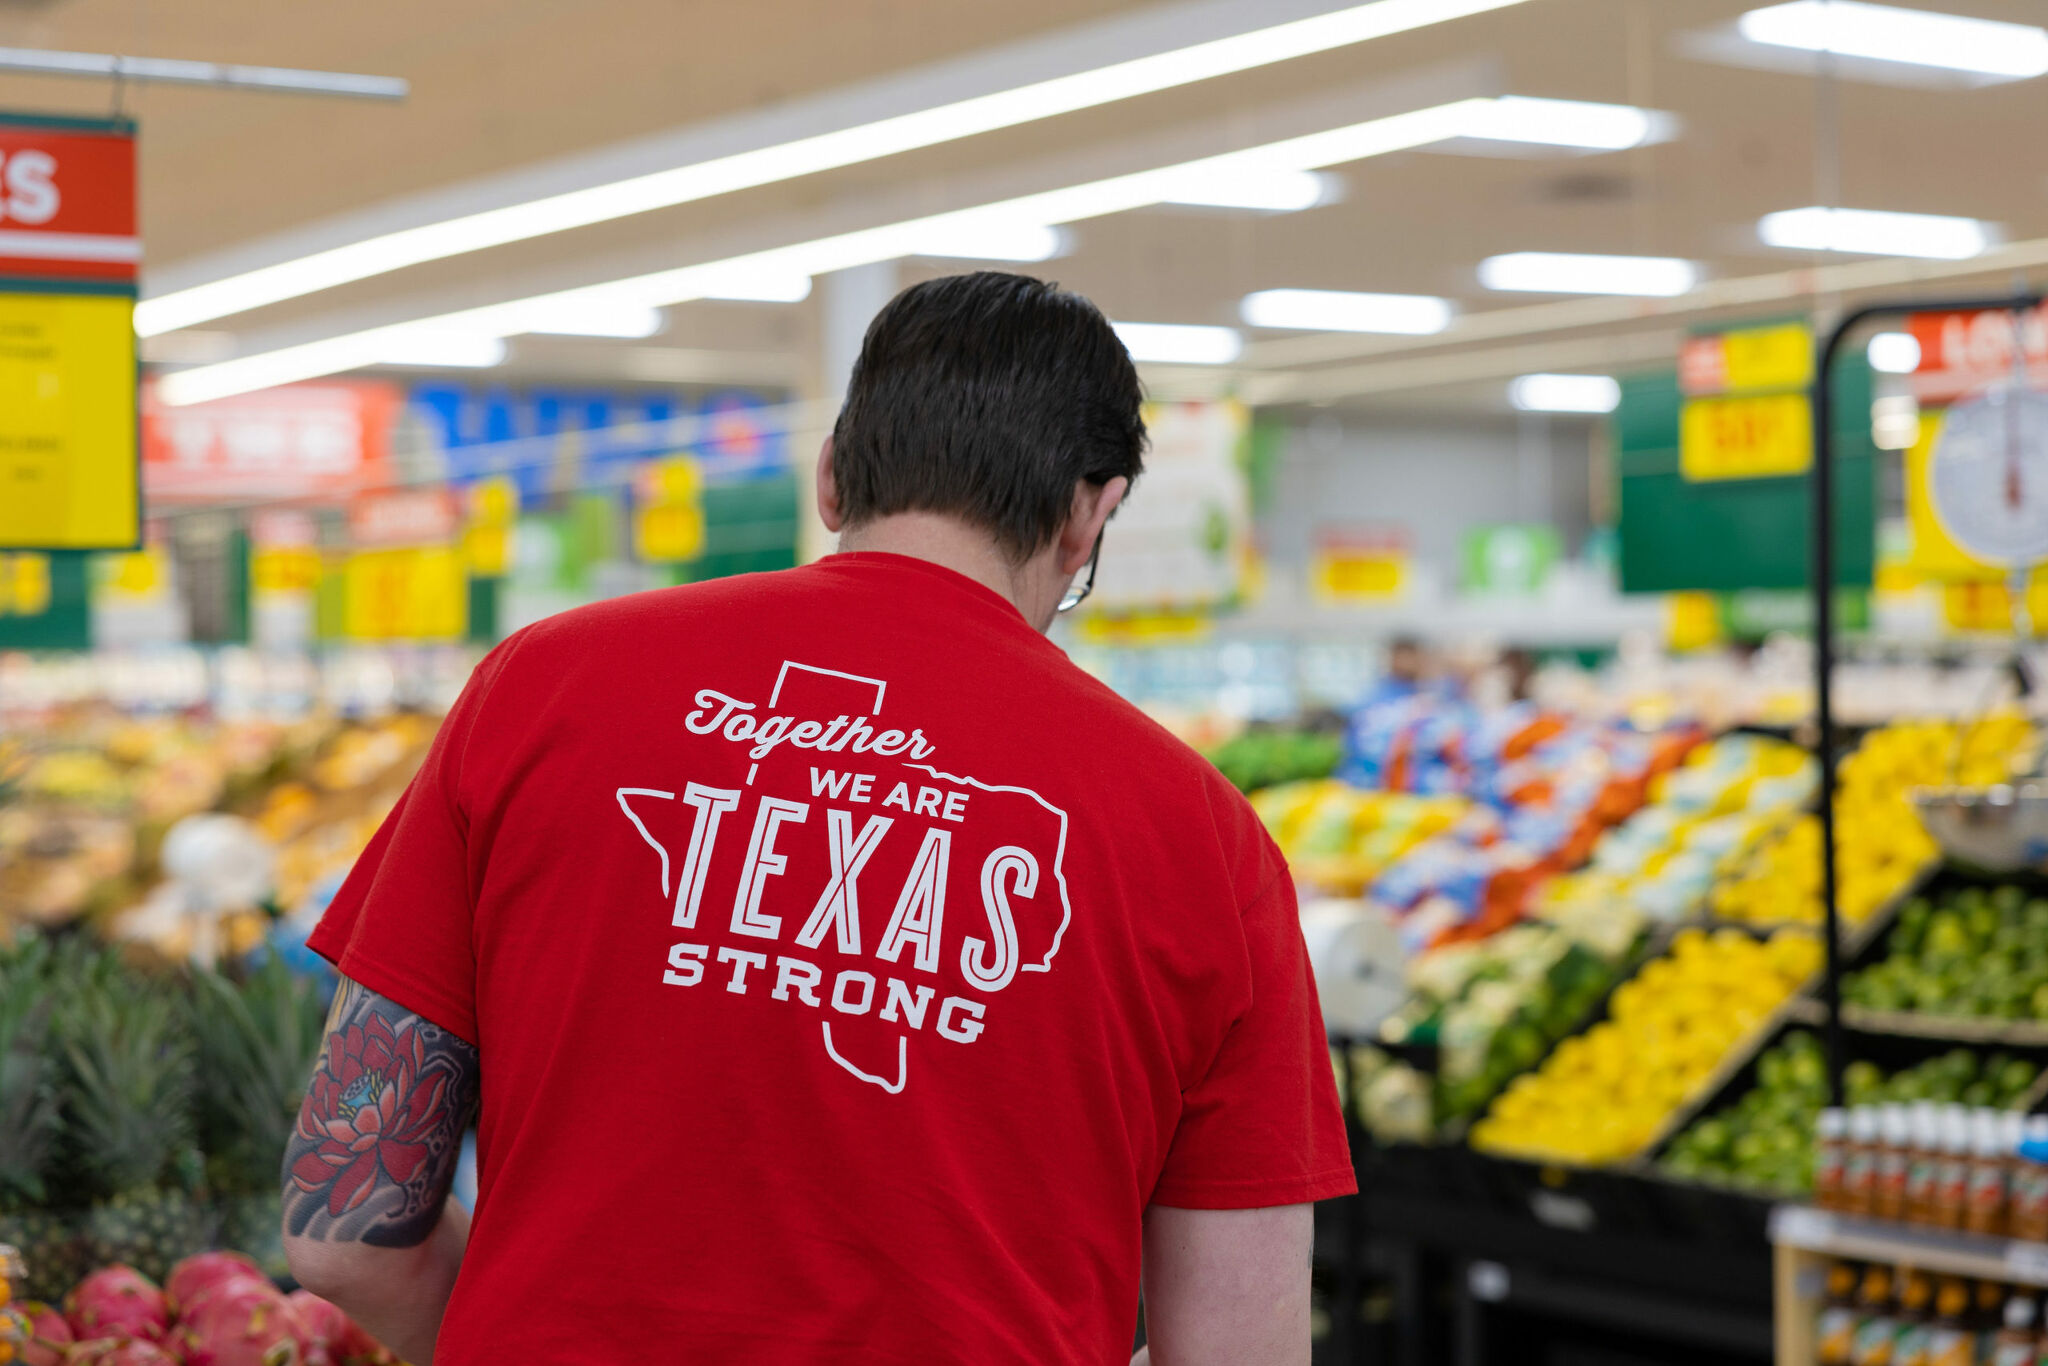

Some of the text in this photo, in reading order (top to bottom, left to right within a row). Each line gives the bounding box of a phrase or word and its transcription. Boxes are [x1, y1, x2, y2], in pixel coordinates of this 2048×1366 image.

[685, 689, 935, 759] Together
[810, 767, 969, 822] WE ARE
[672, 781, 1039, 992] TEXAS
[663, 943, 986, 1043] STRONG
